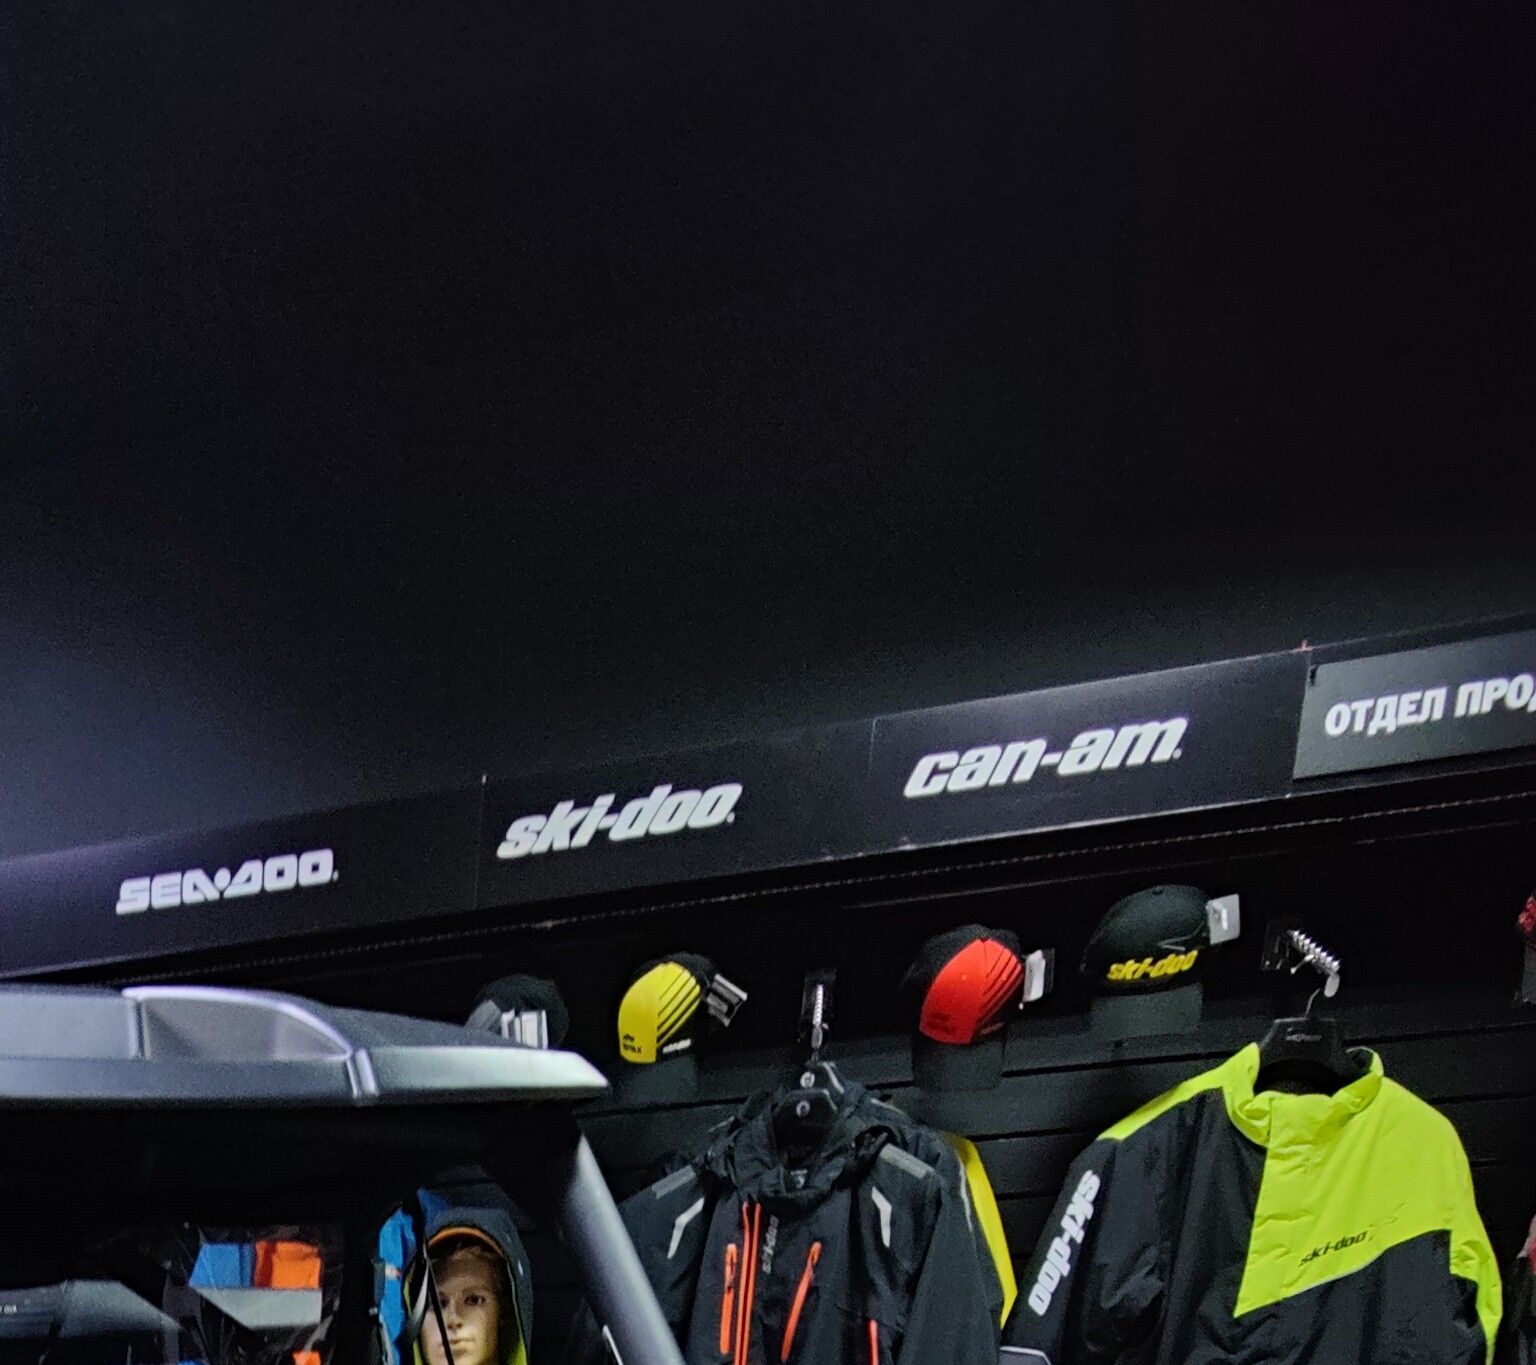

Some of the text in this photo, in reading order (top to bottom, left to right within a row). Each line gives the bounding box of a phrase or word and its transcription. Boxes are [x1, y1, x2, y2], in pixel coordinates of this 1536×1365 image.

[1324, 672, 1536, 736] ОТДЕЛ ПРО
[903, 717, 1188, 799] can-am
[496, 783, 743, 859] ski-doo
[1107, 949, 1198, 980] ski-doo
[1028, 1169, 1100, 1316] ski-doo
[1298, 1230, 1367, 1268] ski-doo
